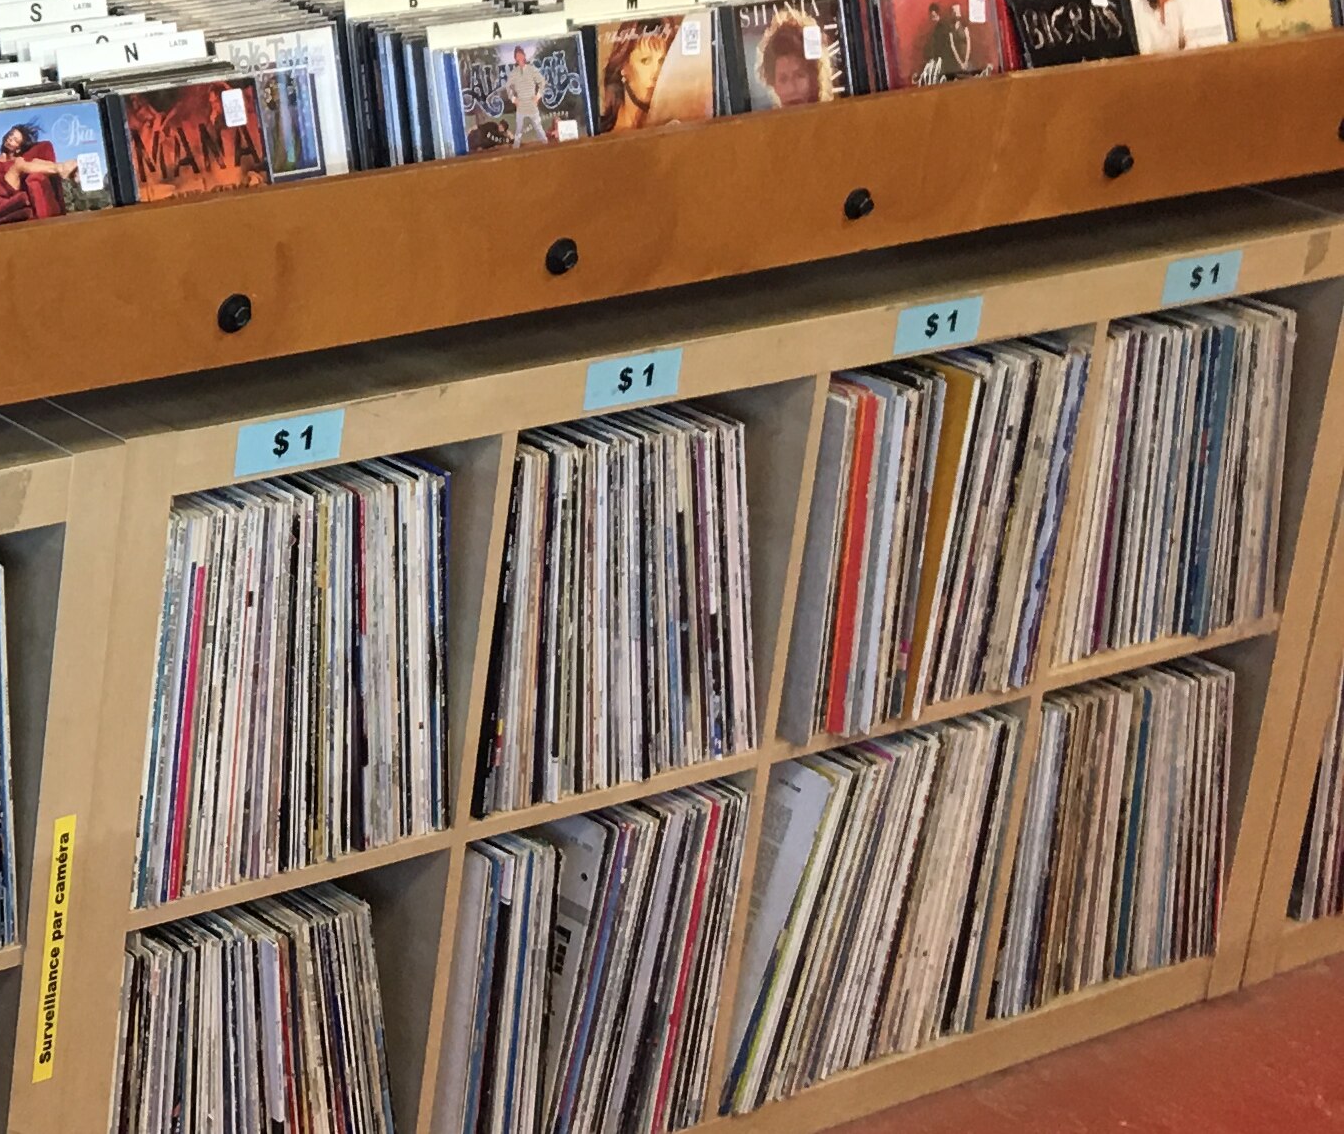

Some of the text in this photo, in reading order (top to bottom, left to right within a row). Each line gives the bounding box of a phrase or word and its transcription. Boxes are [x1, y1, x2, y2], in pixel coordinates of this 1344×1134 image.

[1189, 262, 1220, 289] $ 1
[925, 310, 958, 338] $ 1
[618, 363, 655, 393] $ 1
[273, 426, 313, 457] $ 1
[39, 832, 70, 1065] Surveillance par caméra
